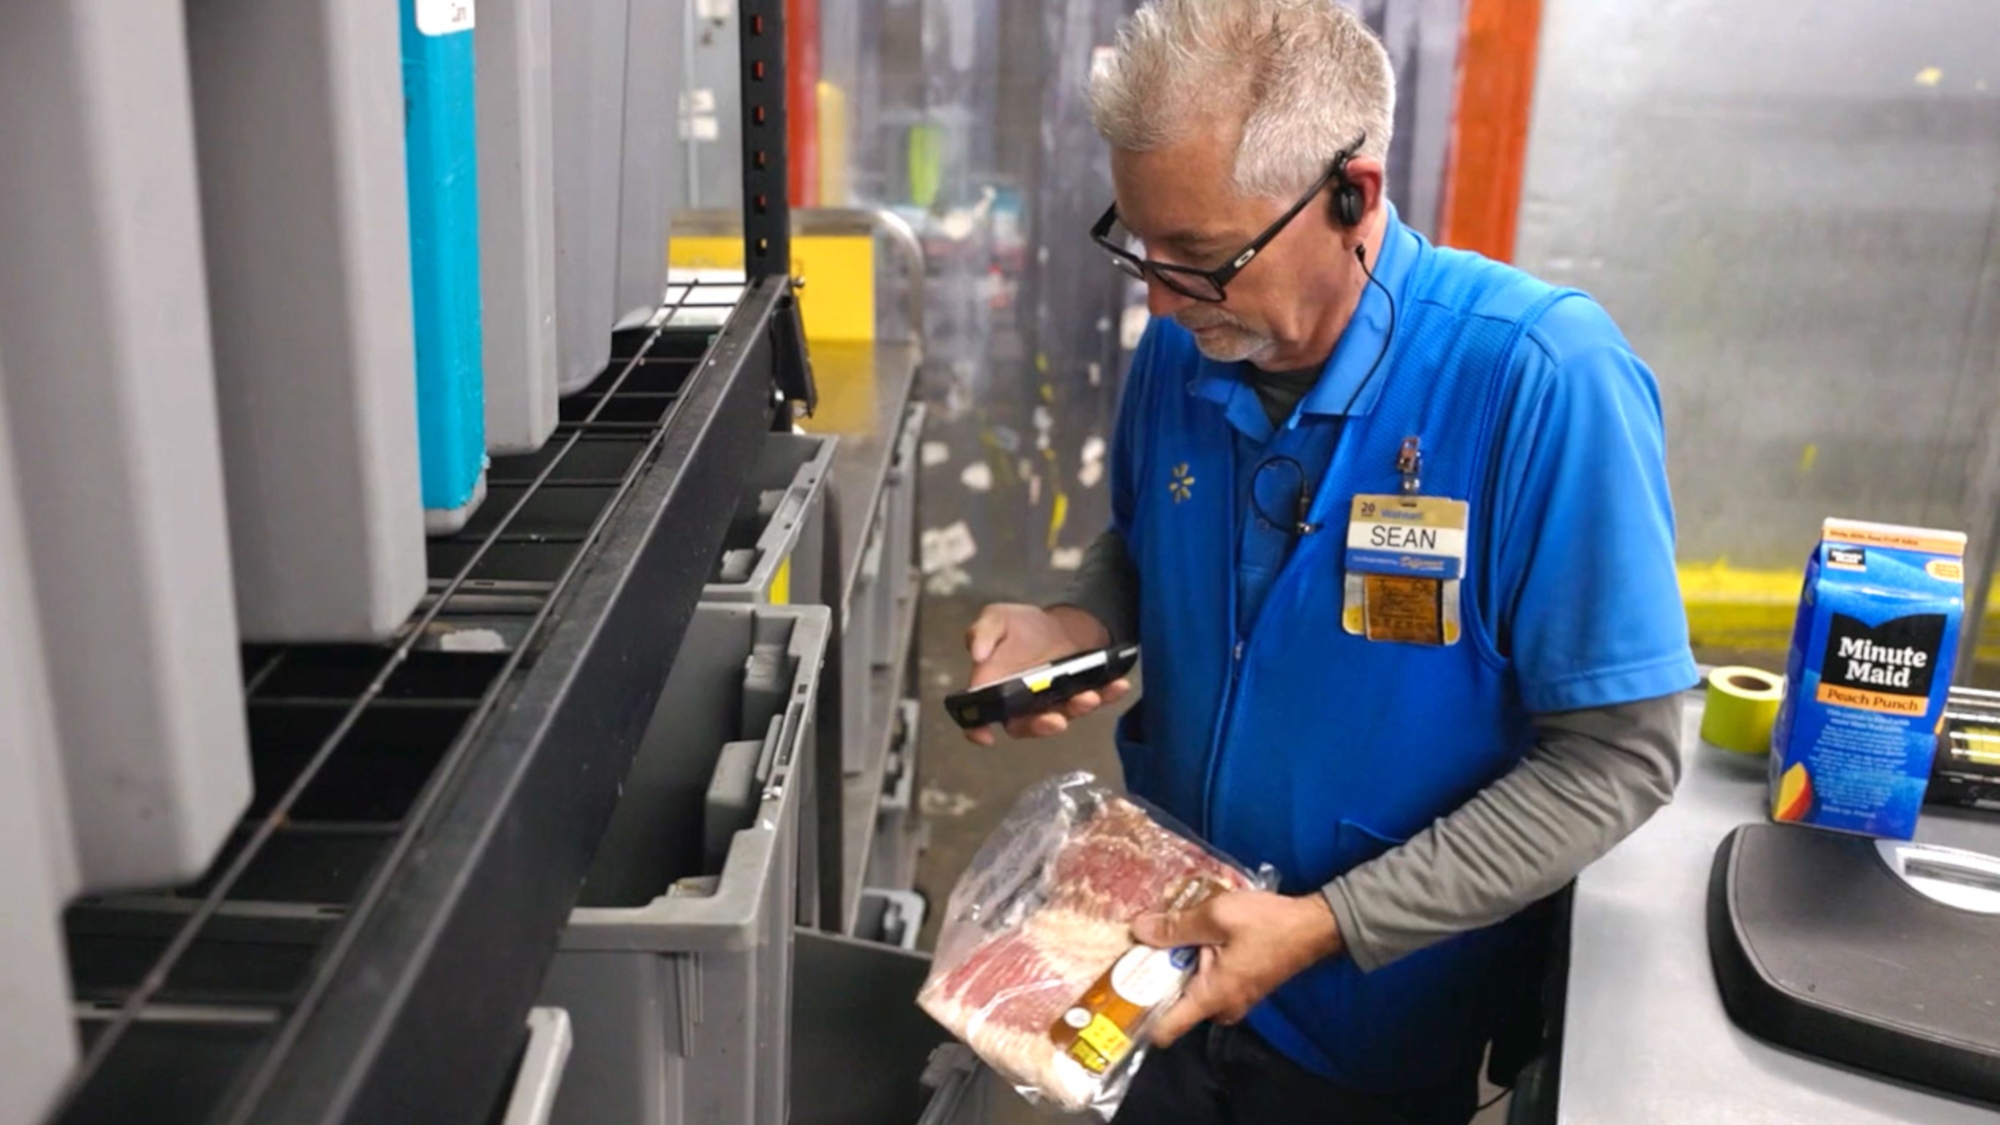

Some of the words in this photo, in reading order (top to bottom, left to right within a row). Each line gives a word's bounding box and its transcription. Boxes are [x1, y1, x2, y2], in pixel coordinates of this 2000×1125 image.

[1361, 502, 1376, 514] 20
[1371, 525, 1437, 550] SEAN
[1837, 636, 1928, 668] Minute
[1844, 659, 1911, 688] Maid
[1827, 688, 1870, 706] Peach
[1873, 696, 1919, 712] Punch
